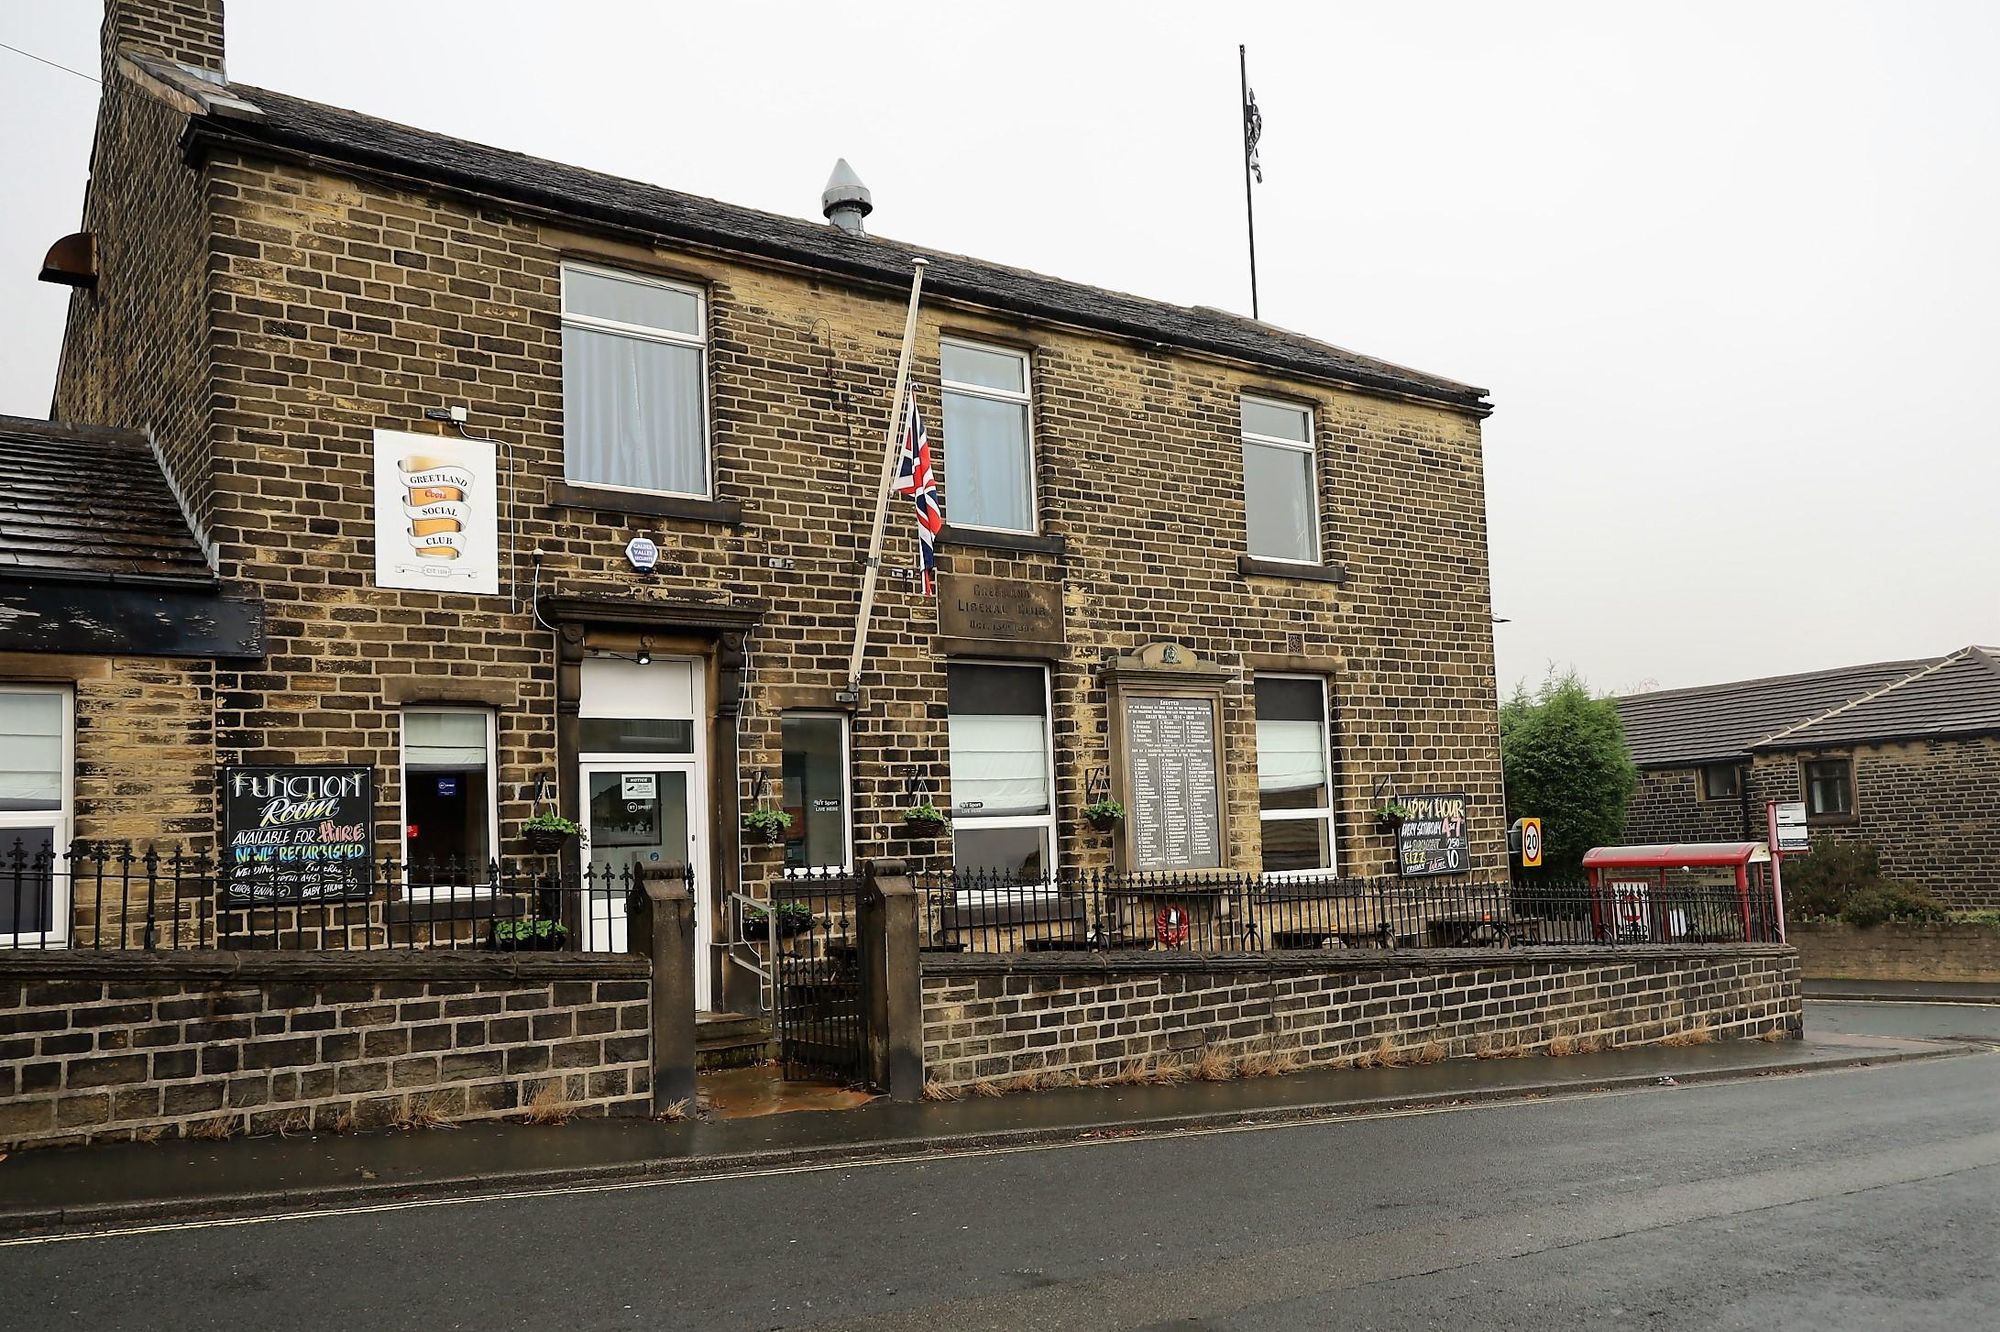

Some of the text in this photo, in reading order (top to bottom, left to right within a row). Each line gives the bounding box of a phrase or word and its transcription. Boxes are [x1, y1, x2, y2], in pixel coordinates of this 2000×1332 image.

[410, 474, 468, 488] GREETLAND
[422, 506, 458, 517] SOCIAL
[425, 536, 453, 546] CLUB
[234, 775, 361, 797] FUNCTION
[1434, 797, 1465, 818] HOUR
[231, 820, 366, 845] AVAILABLE FOR HIRE
[1526, 834, 1538, 850] 20
[1404, 852, 1426, 864] FIZZ
[302, 886, 321, 897] BABY
